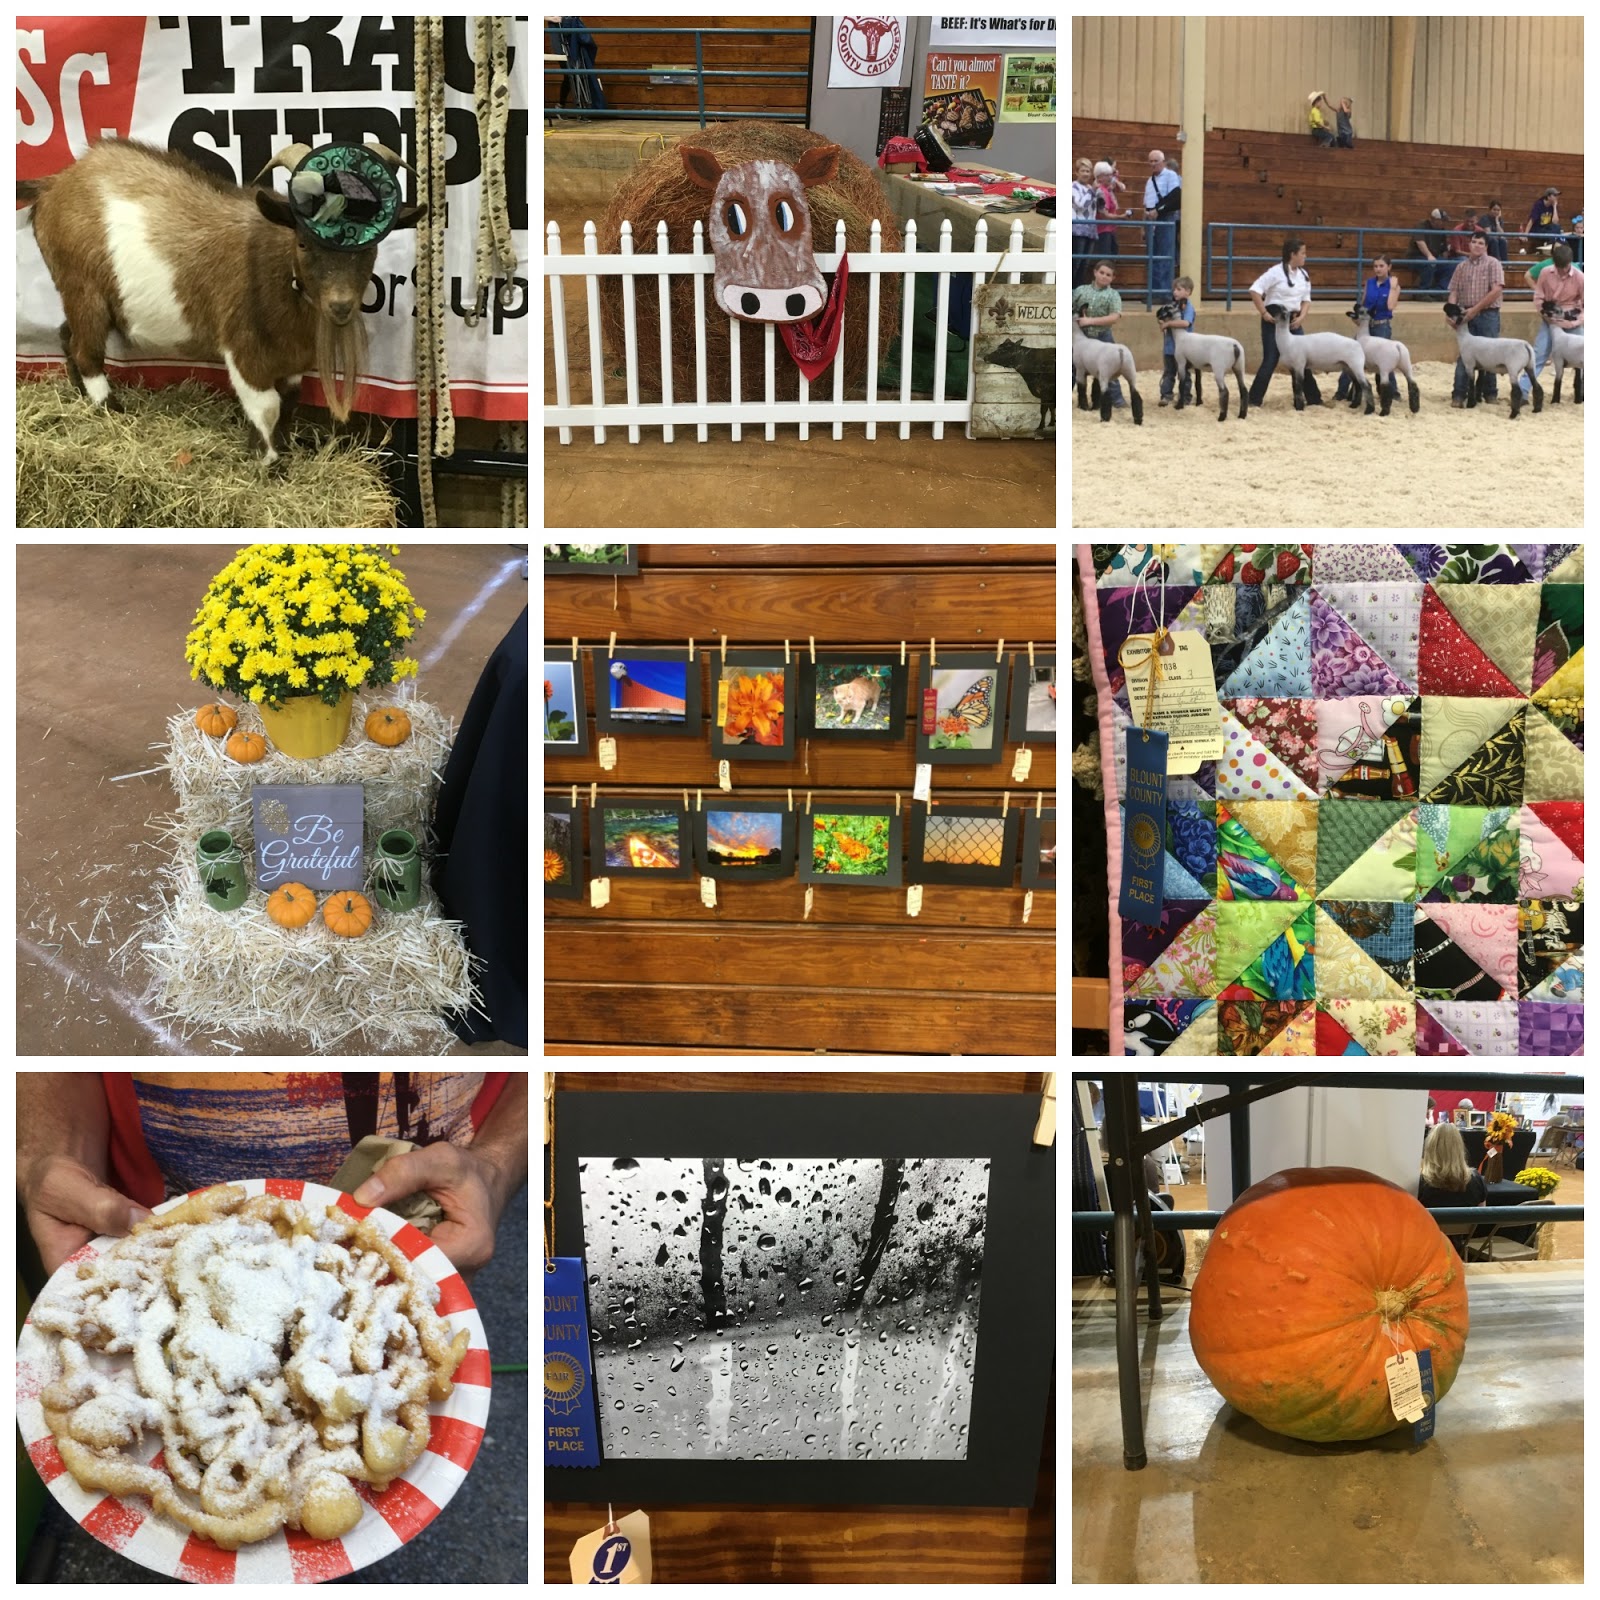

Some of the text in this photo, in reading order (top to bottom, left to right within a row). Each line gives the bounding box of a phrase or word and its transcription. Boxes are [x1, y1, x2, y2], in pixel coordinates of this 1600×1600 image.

[941, 17, 1056, 31] BEEF: It's What's for D
[840, 25, 861, 70] COUNTY
[931, 56, 996, 74] Can't you almost
[931, 74, 971, 90] TASTE it?
[1179, 644, 1189, 652] TAG
[1130, 768, 1164, 787] BLOUNT
[1130, 787, 1163, 806] COUNTY
[293, 814, 344, 845] Be
[259, 839, 360, 882] Grateful
[1131, 875, 1154, 890] FIRST
[1128, 888, 1155, 904] PLACE
[544, 1325, 581, 1341] UNTY
[546, 1372, 569, 1381] FAIR
[548, 1426, 580, 1438] FIRST
[548, 1440, 584, 1451] PLACE
[600, 1542, 628, 1574] 1ST
